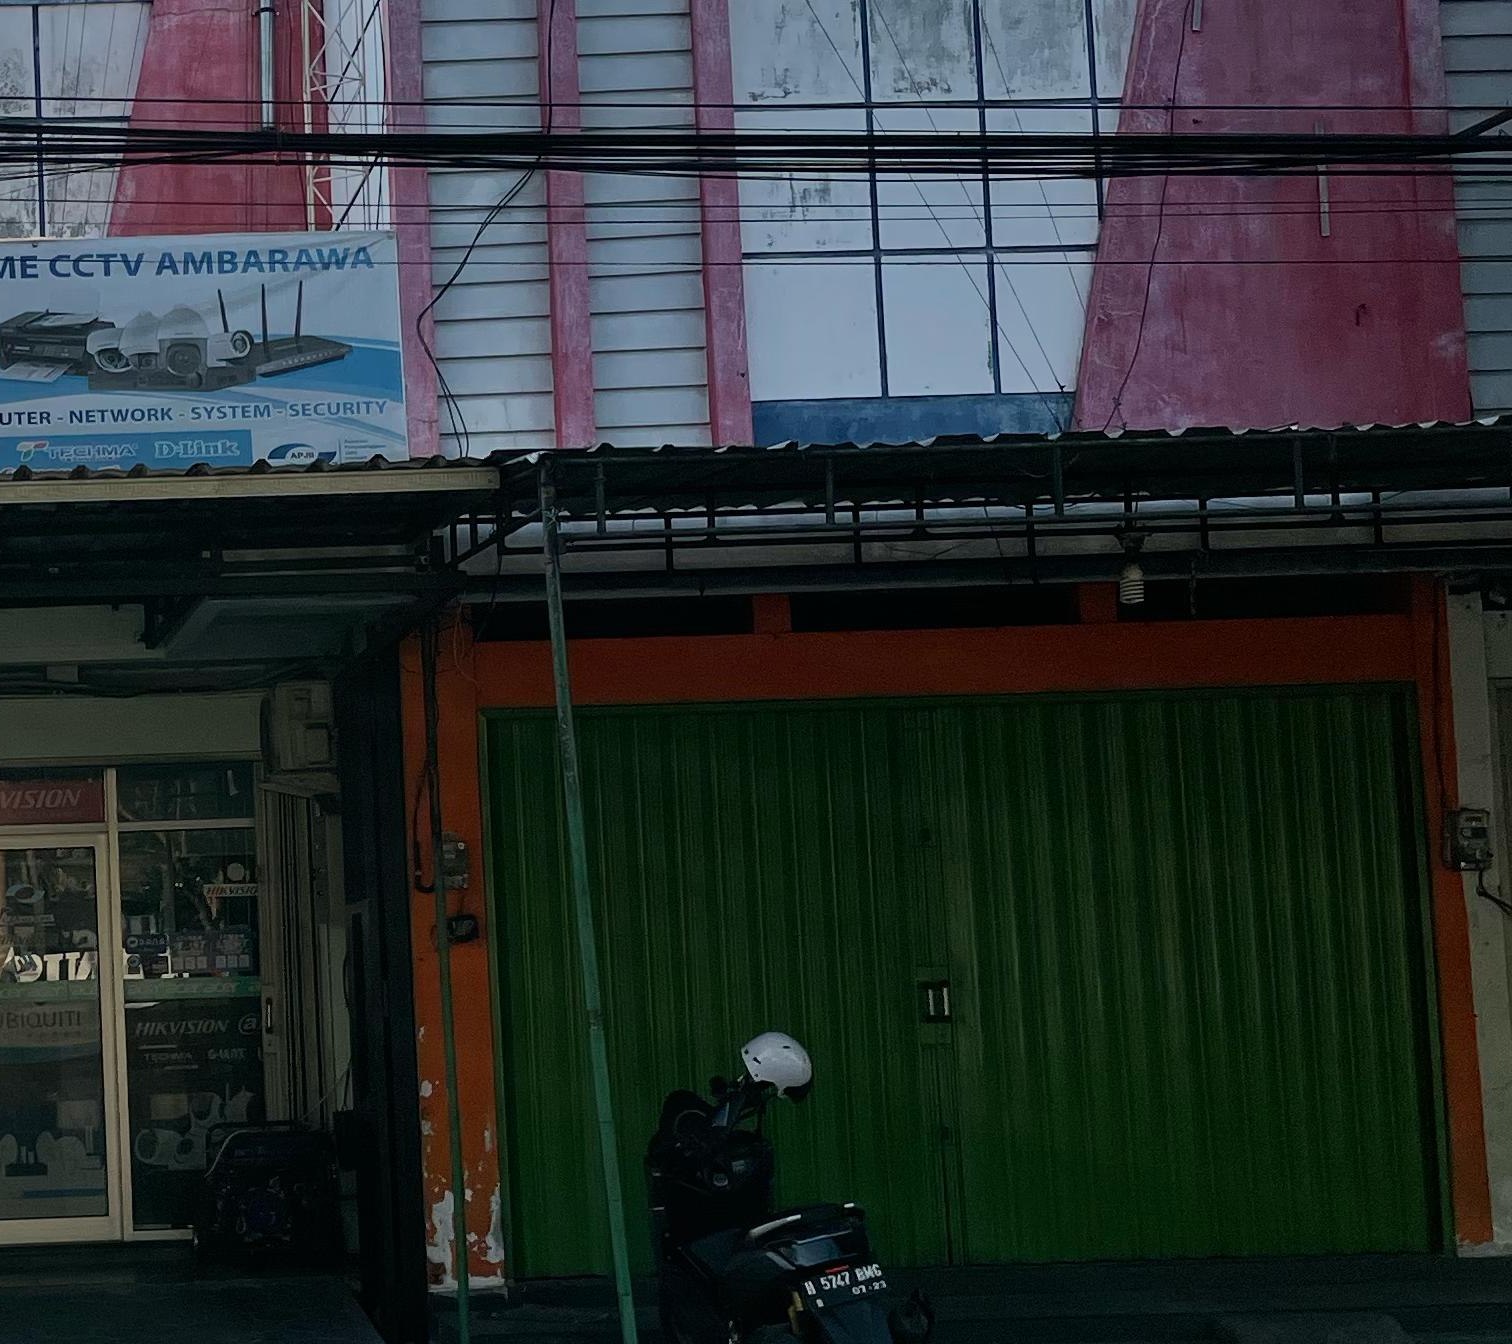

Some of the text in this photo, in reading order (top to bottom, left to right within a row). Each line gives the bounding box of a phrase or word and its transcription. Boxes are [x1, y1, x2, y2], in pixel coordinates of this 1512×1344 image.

[49, 253, 144, 278] CCTV
[155, 246, 375, 276] AMBARAWA
[69, 407, 173, 425] NETWORK
[191, 404, 271, 421] SYSTEM
[289, 400, 387, 417] SECURITY
[154, 439, 240, 459] D-Link
[135, 1019, 230, 1037] HIKVISION
[820, 1271, 850, 1290] 5747
